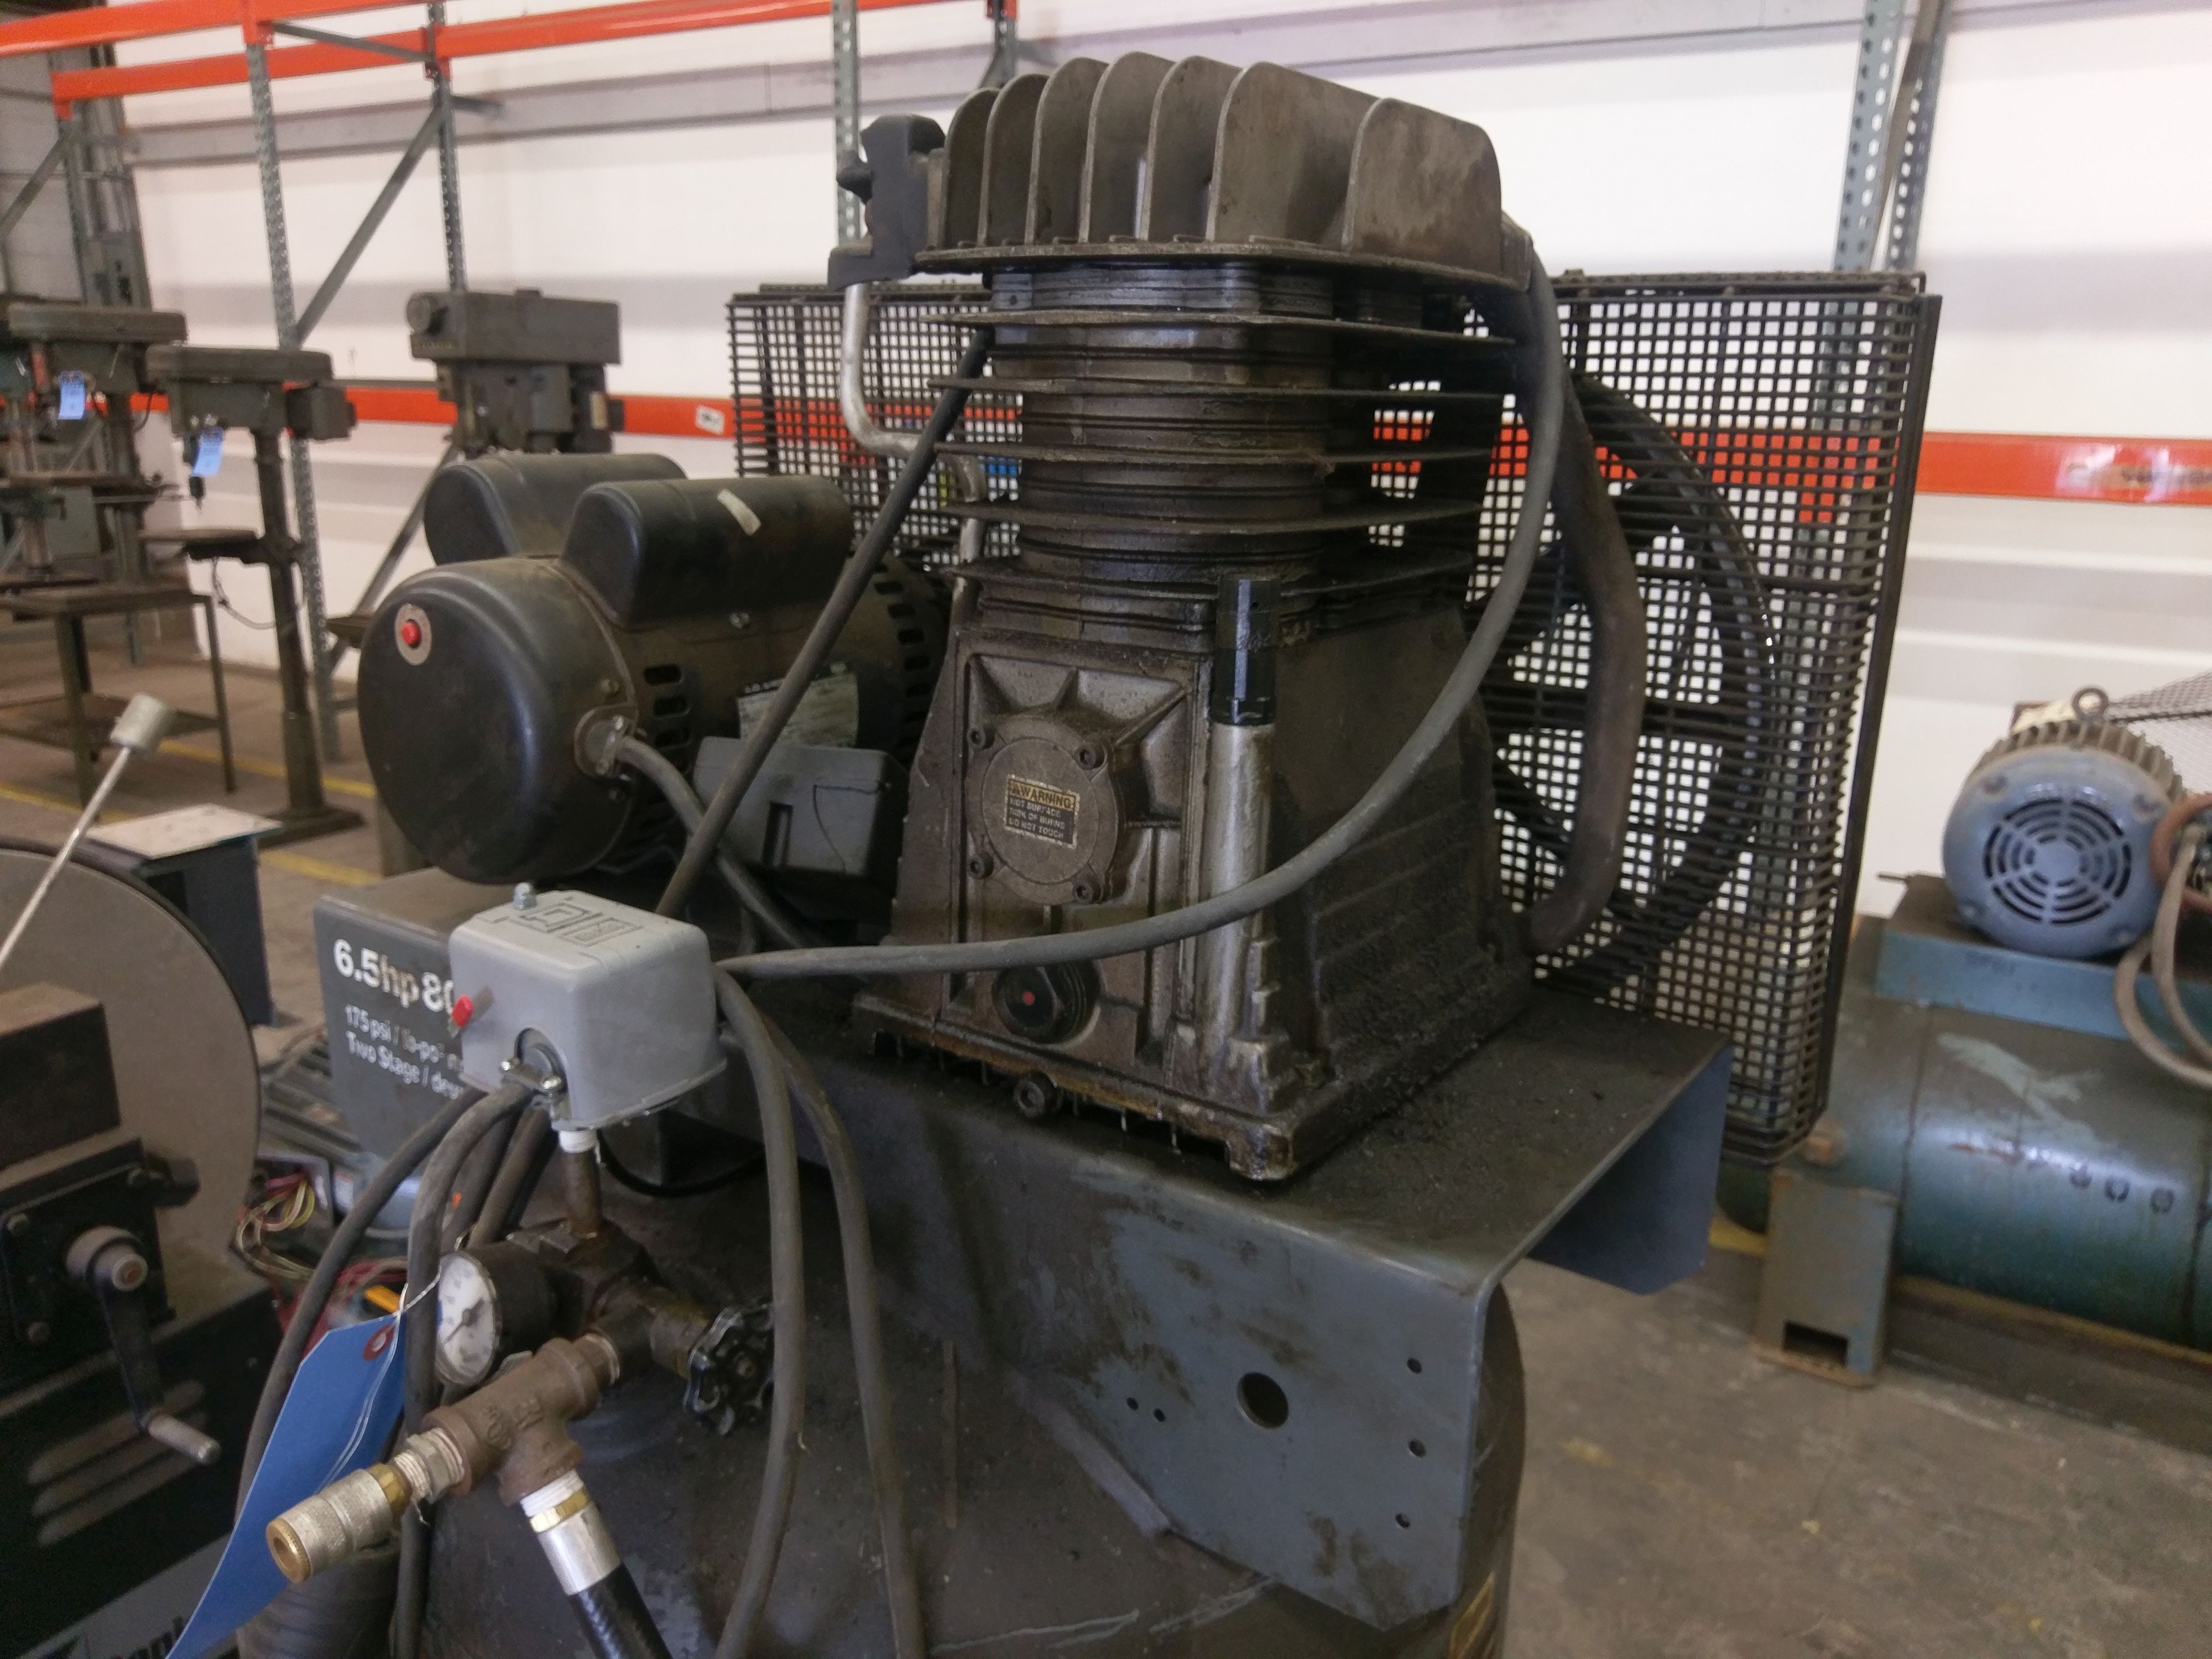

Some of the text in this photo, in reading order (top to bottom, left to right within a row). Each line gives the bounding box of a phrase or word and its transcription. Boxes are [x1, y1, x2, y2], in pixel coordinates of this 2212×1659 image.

[1020, 785, 1071, 810] WARNING
[1039, 826, 1065, 839] TOUCH
[333, 938, 420, 1009] 6.5hp
[345, 1030, 377, 1063] Two
[378, 1045, 420, 1084] Stage
